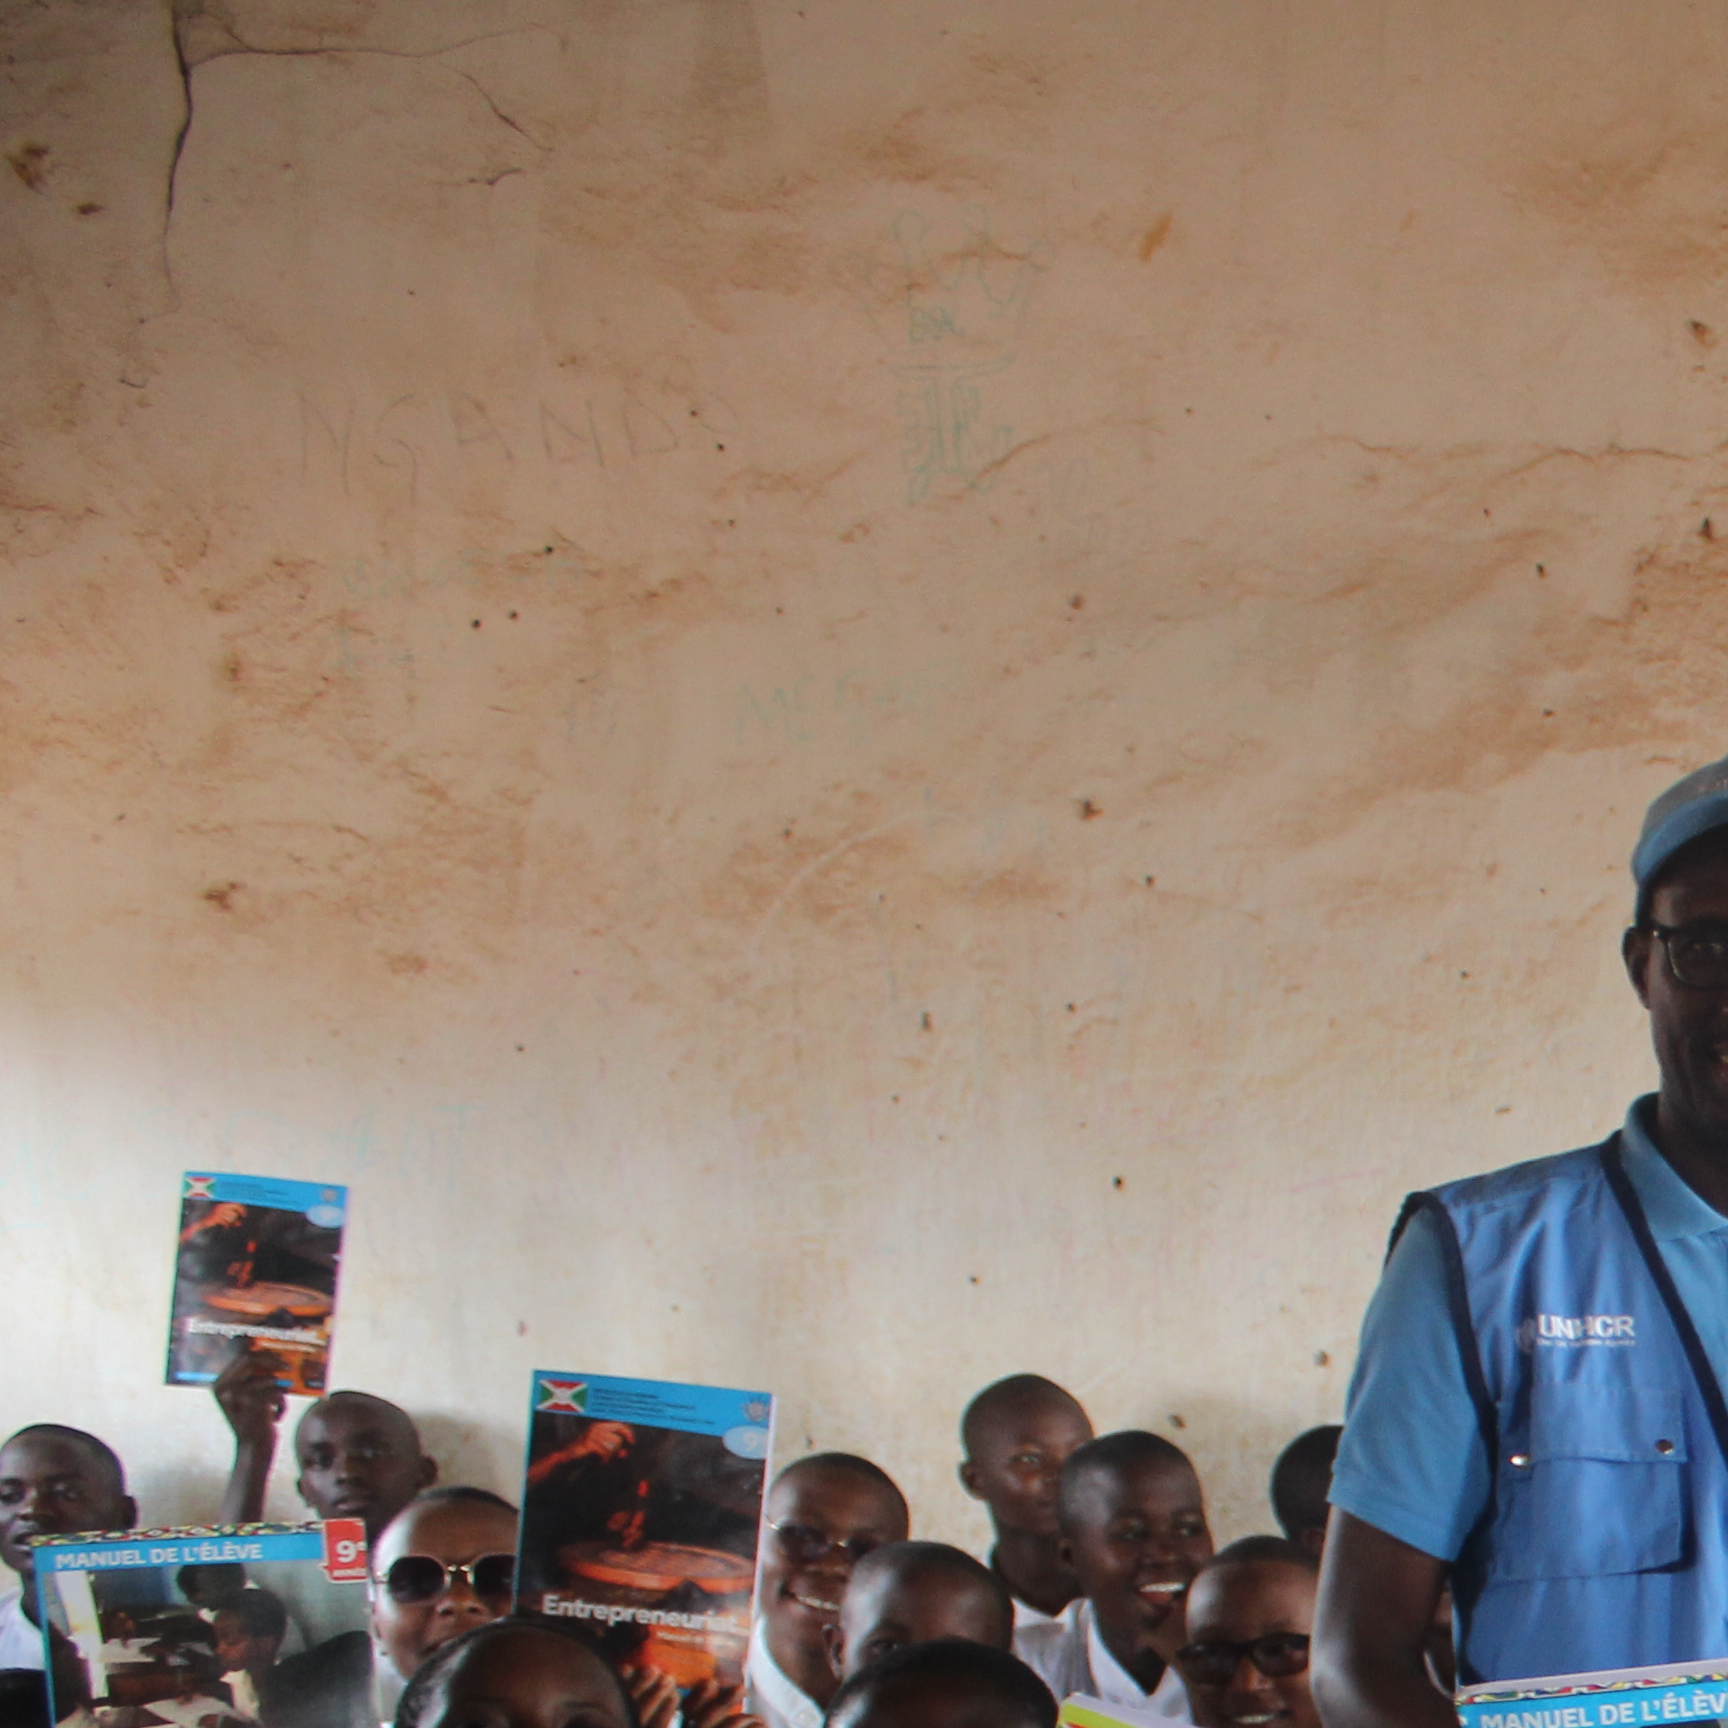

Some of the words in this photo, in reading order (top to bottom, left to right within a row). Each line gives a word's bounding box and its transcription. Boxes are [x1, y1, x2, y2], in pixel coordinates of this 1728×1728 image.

[55, 1549, 146, 1569] MANUEL
[151, 1547, 180, 1564] DE
[183, 1541, 264, 1562] L'ÉLÈVE
[542, 1594, 739, 1633] Entrepreneuriat
[1600, 1702, 1635, 1727] DE
